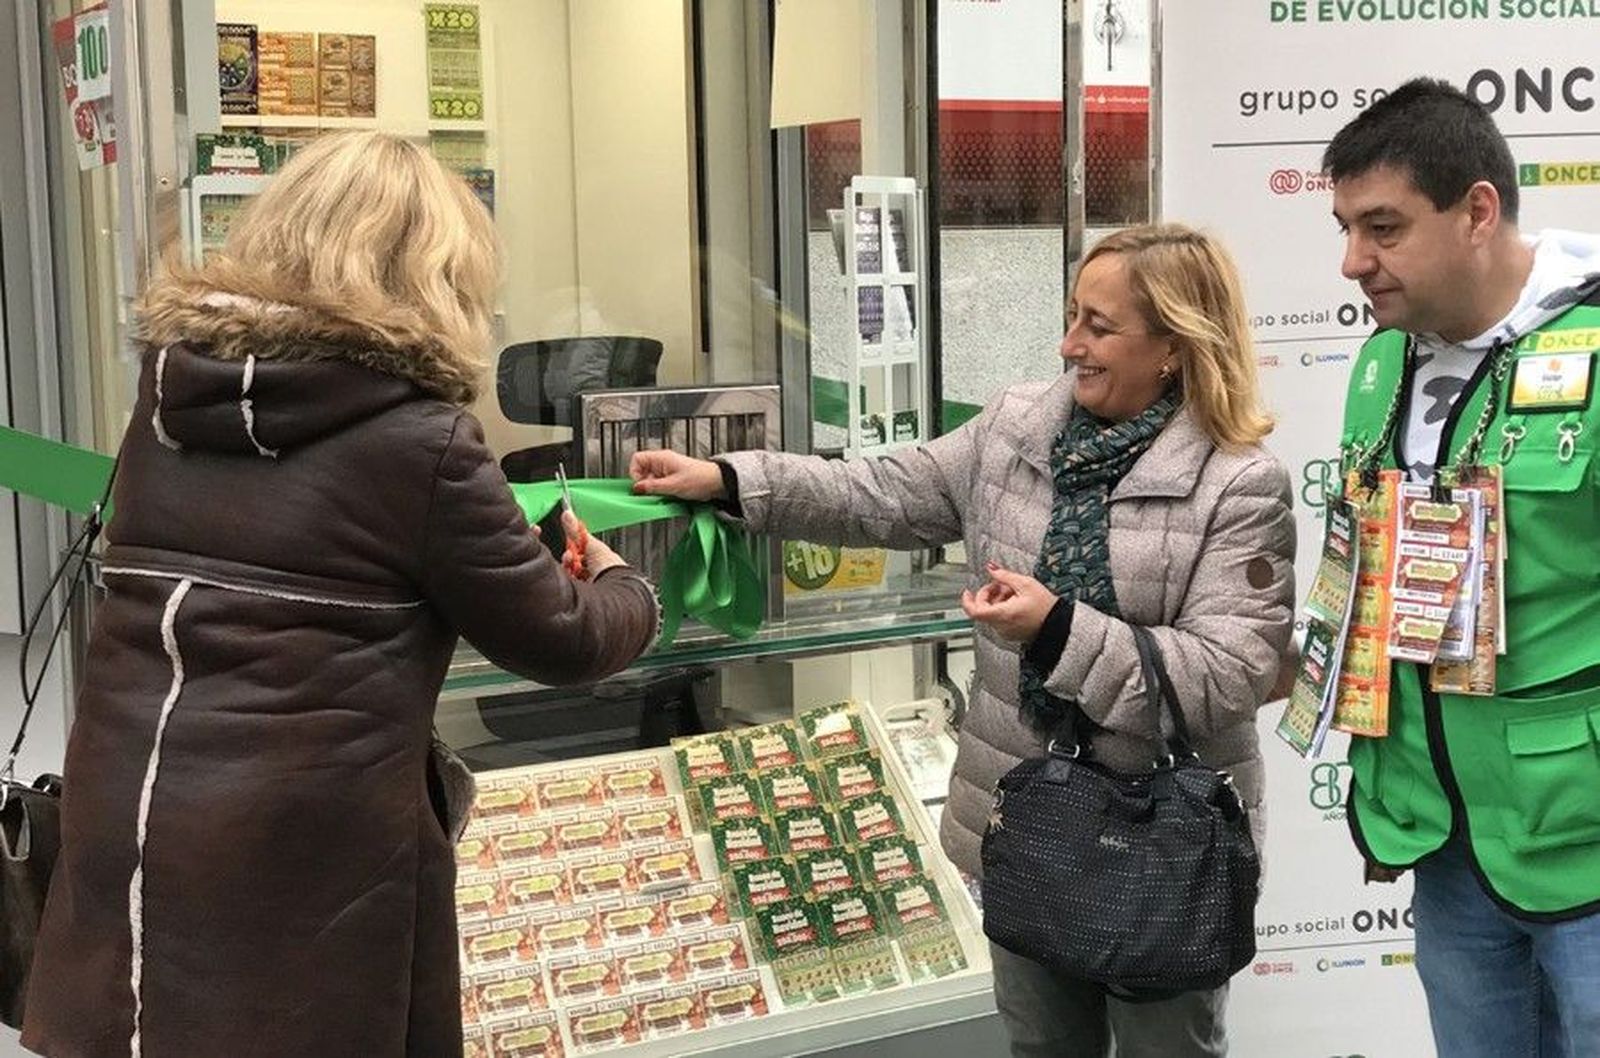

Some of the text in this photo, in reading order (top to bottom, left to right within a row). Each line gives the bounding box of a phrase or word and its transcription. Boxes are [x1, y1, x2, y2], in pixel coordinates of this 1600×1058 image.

[1270, 3, 1306, 22] DE
[1500, 0, 1600, 18] SOCIAL
[77, 25, 108, 80] 100
[1466, 66, 1595, 114] ONC
[1240, 87, 1338, 116] grupo
[1544, 165, 1600, 182] ONCE
[1306, 180, 1335, 191] ONC
[1281, 310, 1330, 326] social
[1542, 332, 1598, 349] ONCE
[1256, 908, 1416, 938] upo social ONC
